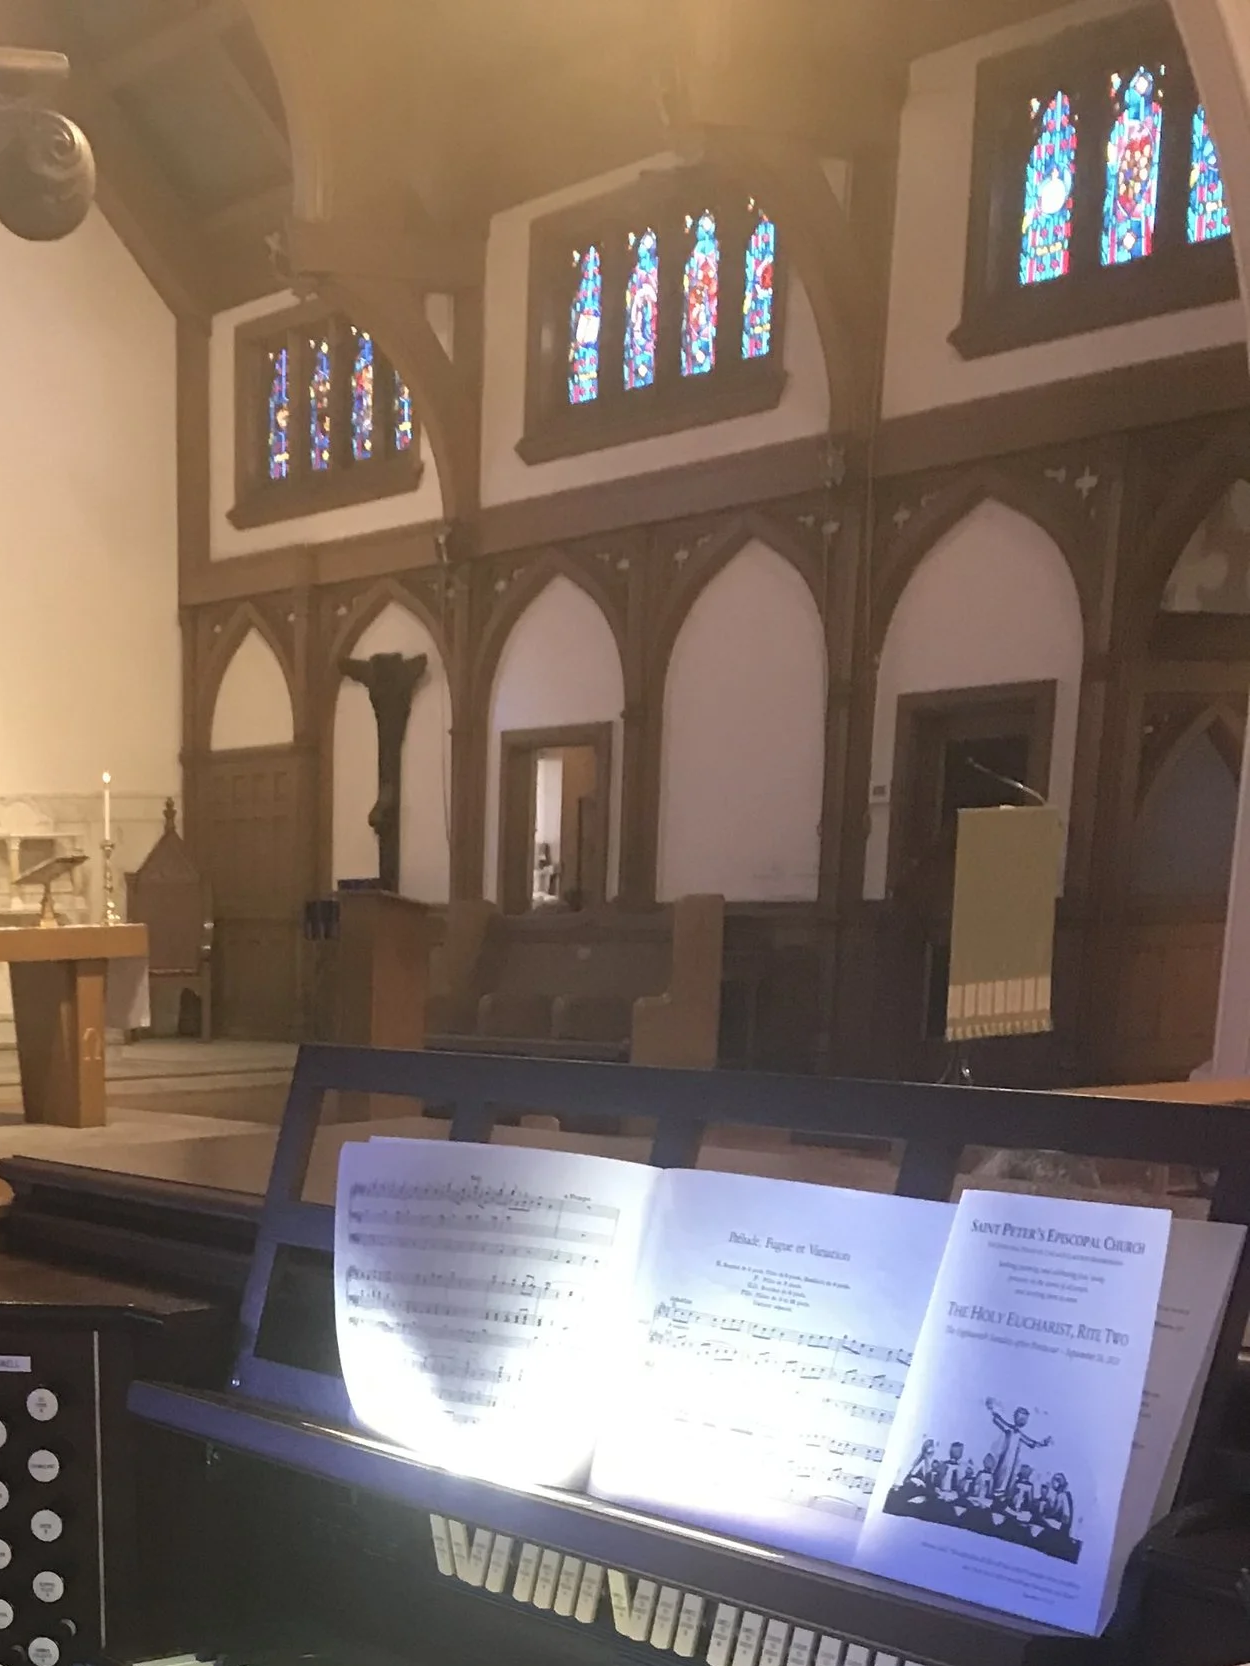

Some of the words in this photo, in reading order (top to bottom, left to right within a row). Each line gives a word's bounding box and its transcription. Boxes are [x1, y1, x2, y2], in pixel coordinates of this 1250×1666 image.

[971, 1218, 1002, 1236] SAINT
[1001, 1222, 1046, 1242] PETER'S
[1046, 1228, 1101, 1249] EPISCOPAL
[1103, 1235, 1146, 1255] CHURCH
[948, 1301, 970, 1319] THE
[970, 1305, 1006, 1324] HOLY
[1006, 1311, 1075, 1339] EUCHARIST,
[1076, 1323, 1101, 1343] RITE
[1104, 1327, 1130, 1347] TWO
